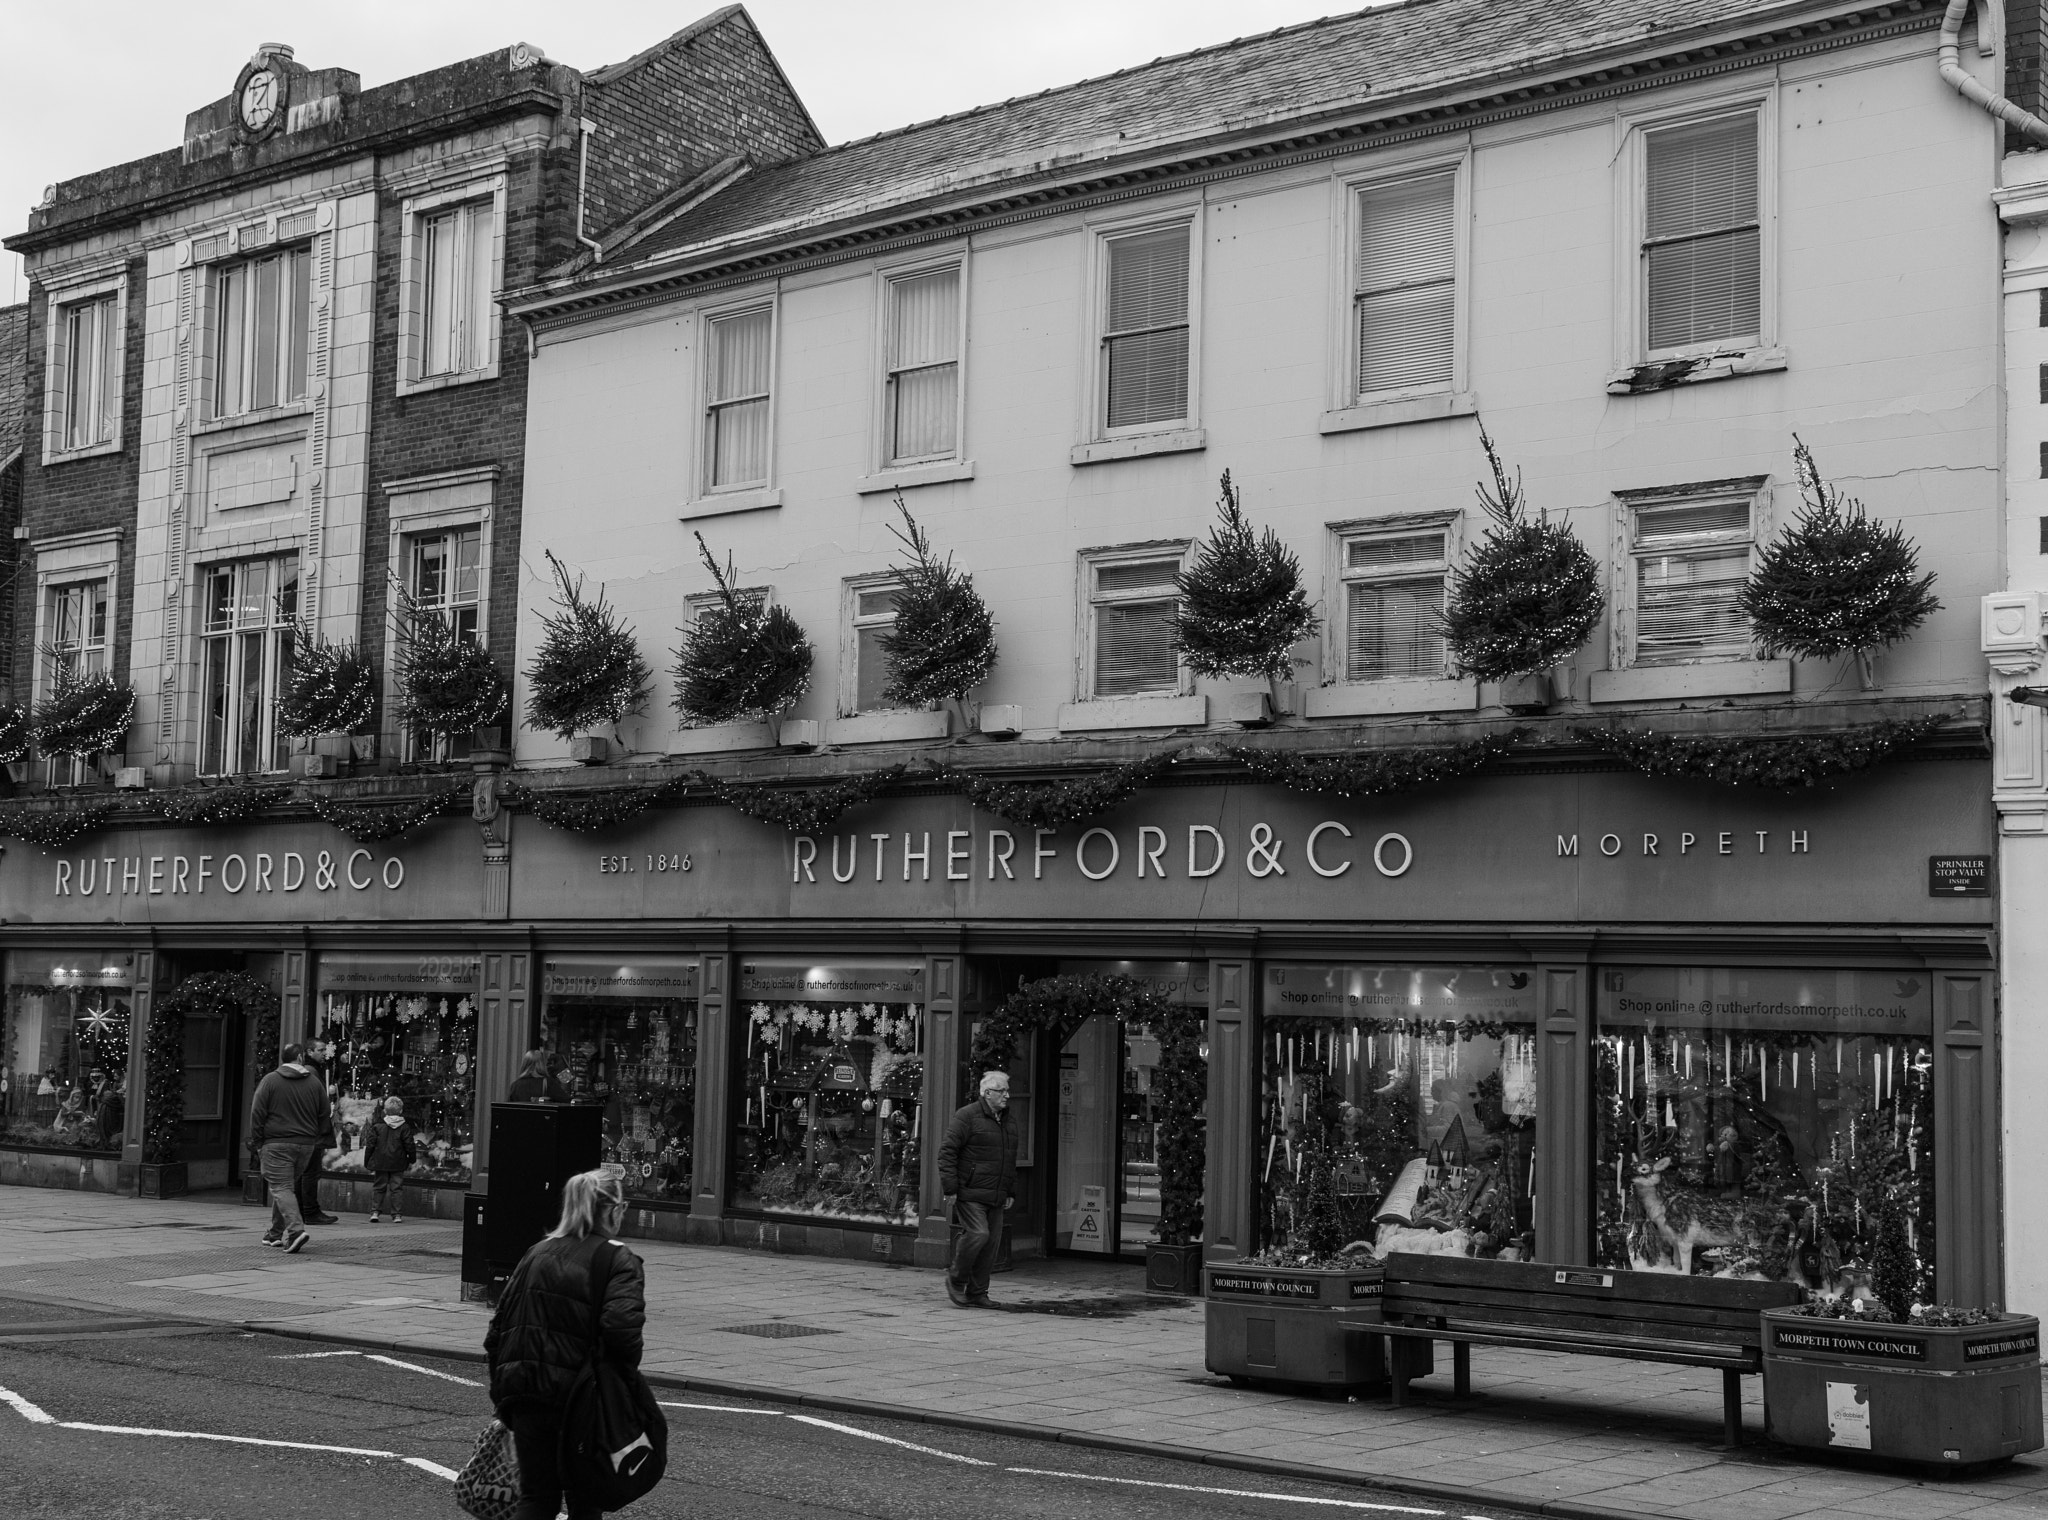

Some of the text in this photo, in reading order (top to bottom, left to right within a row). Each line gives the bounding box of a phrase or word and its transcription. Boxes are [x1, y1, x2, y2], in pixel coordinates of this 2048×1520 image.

[1556, 830, 1809, 856] MORPETH
[600, 853, 693, 874] EST. 1846
[1935, 868, 1985, 876] STOP VALVE
[1936, 860, 1985, 868] SPRINKLER
[1281, 991, 1308, 1005] Shop
[1311, 991, 1344, 1004] online
[1619, 999, 1907, 1019] Shop online @ rutherfordsofmorpeth.co.uk
[1214, 1278, 1315, 1294] MORPETH TOWN COUNCIL
[1779, 1333, 1920, 1355] MORPETH TOWN COUNCIL
[1967, 1337, 2036, 1356] MORPETH TOWN COUNCIL
